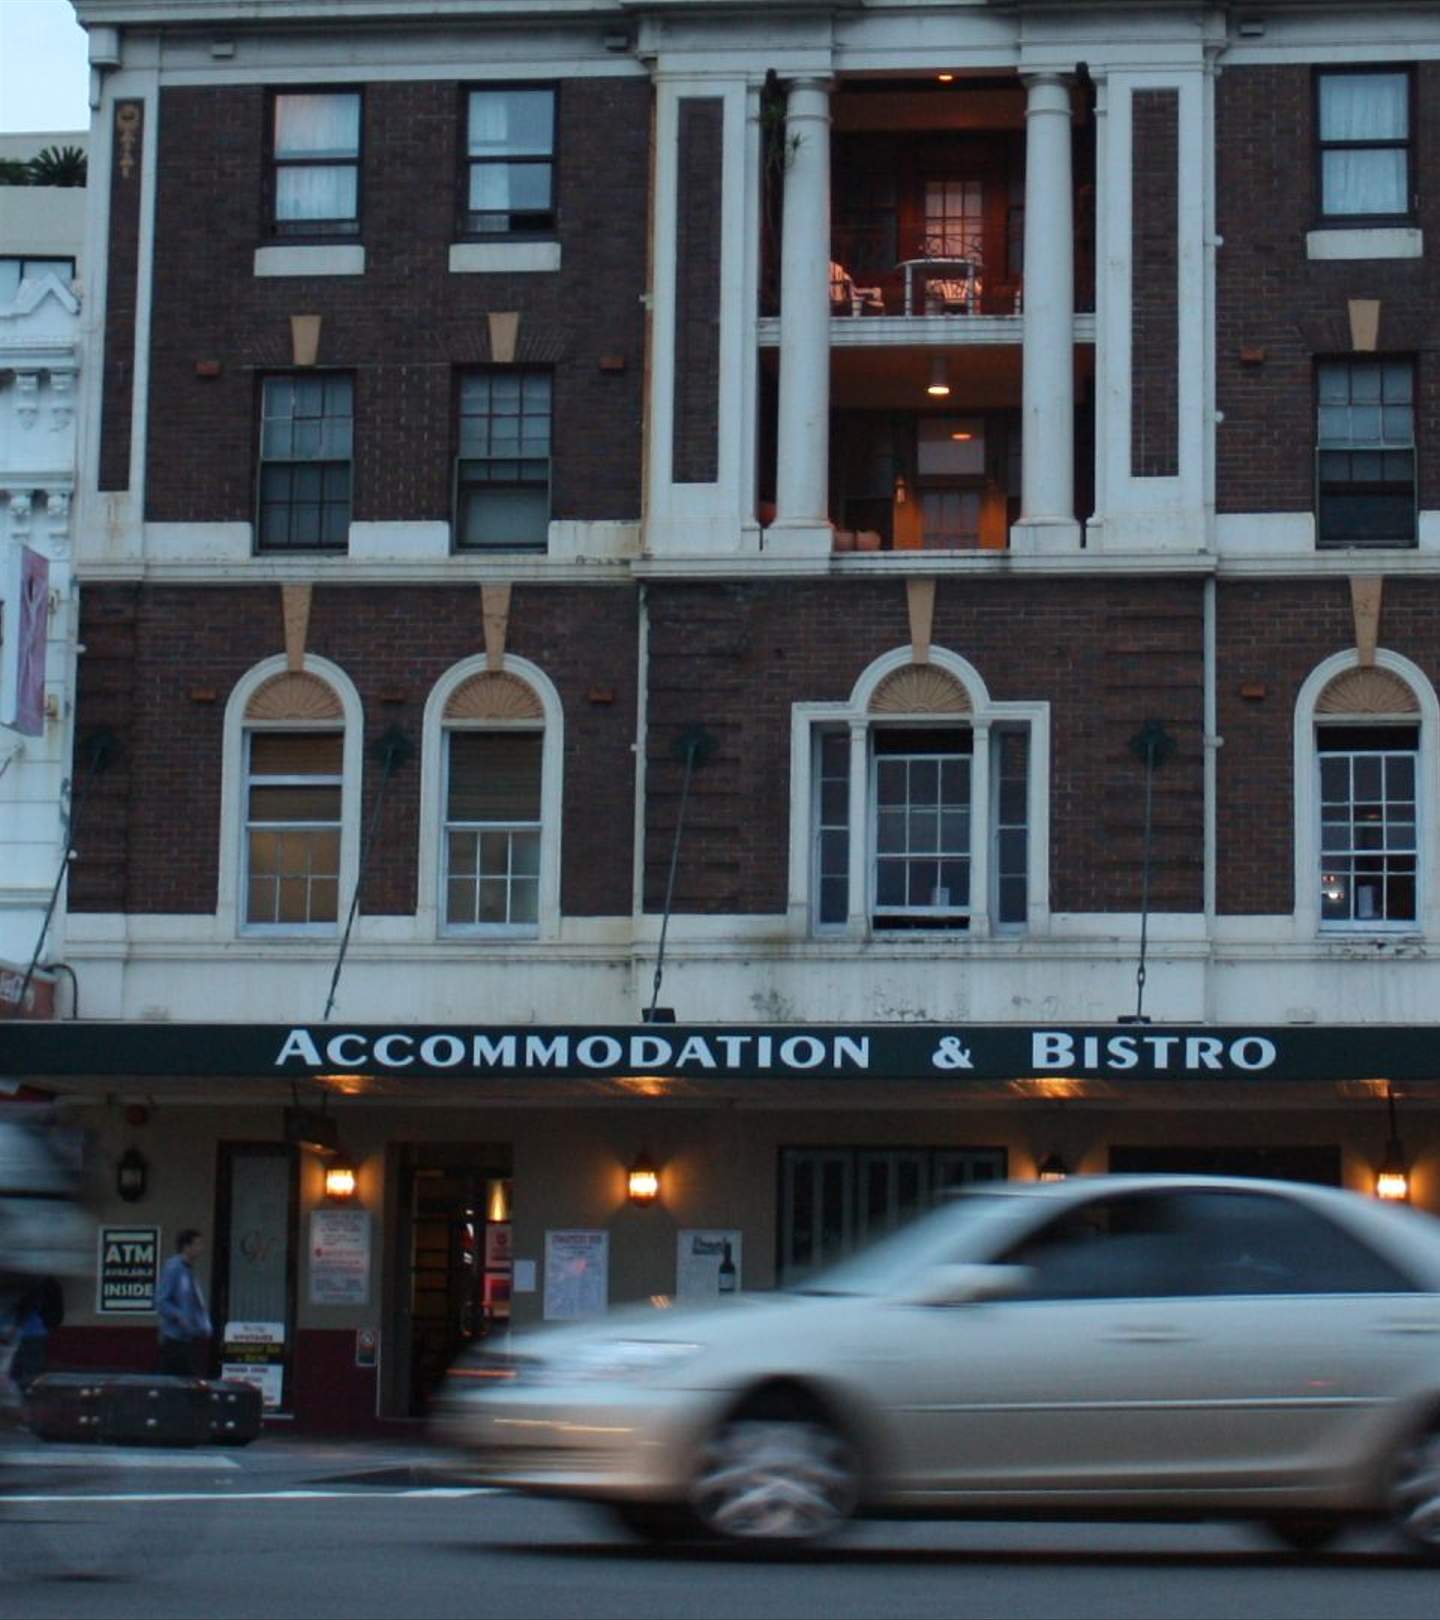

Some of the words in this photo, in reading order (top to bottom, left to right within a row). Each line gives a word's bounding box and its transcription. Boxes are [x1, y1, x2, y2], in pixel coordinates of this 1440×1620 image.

[275, 1029, 869, 1069] ACCOMMODATION
[932, 1036, 974, 1069] &
[1032, 1031, 1277, 1070] BISTRO
[105, 1244, 153, 1263] ATM
[104, 1283, 153, 1297] INSIDE
